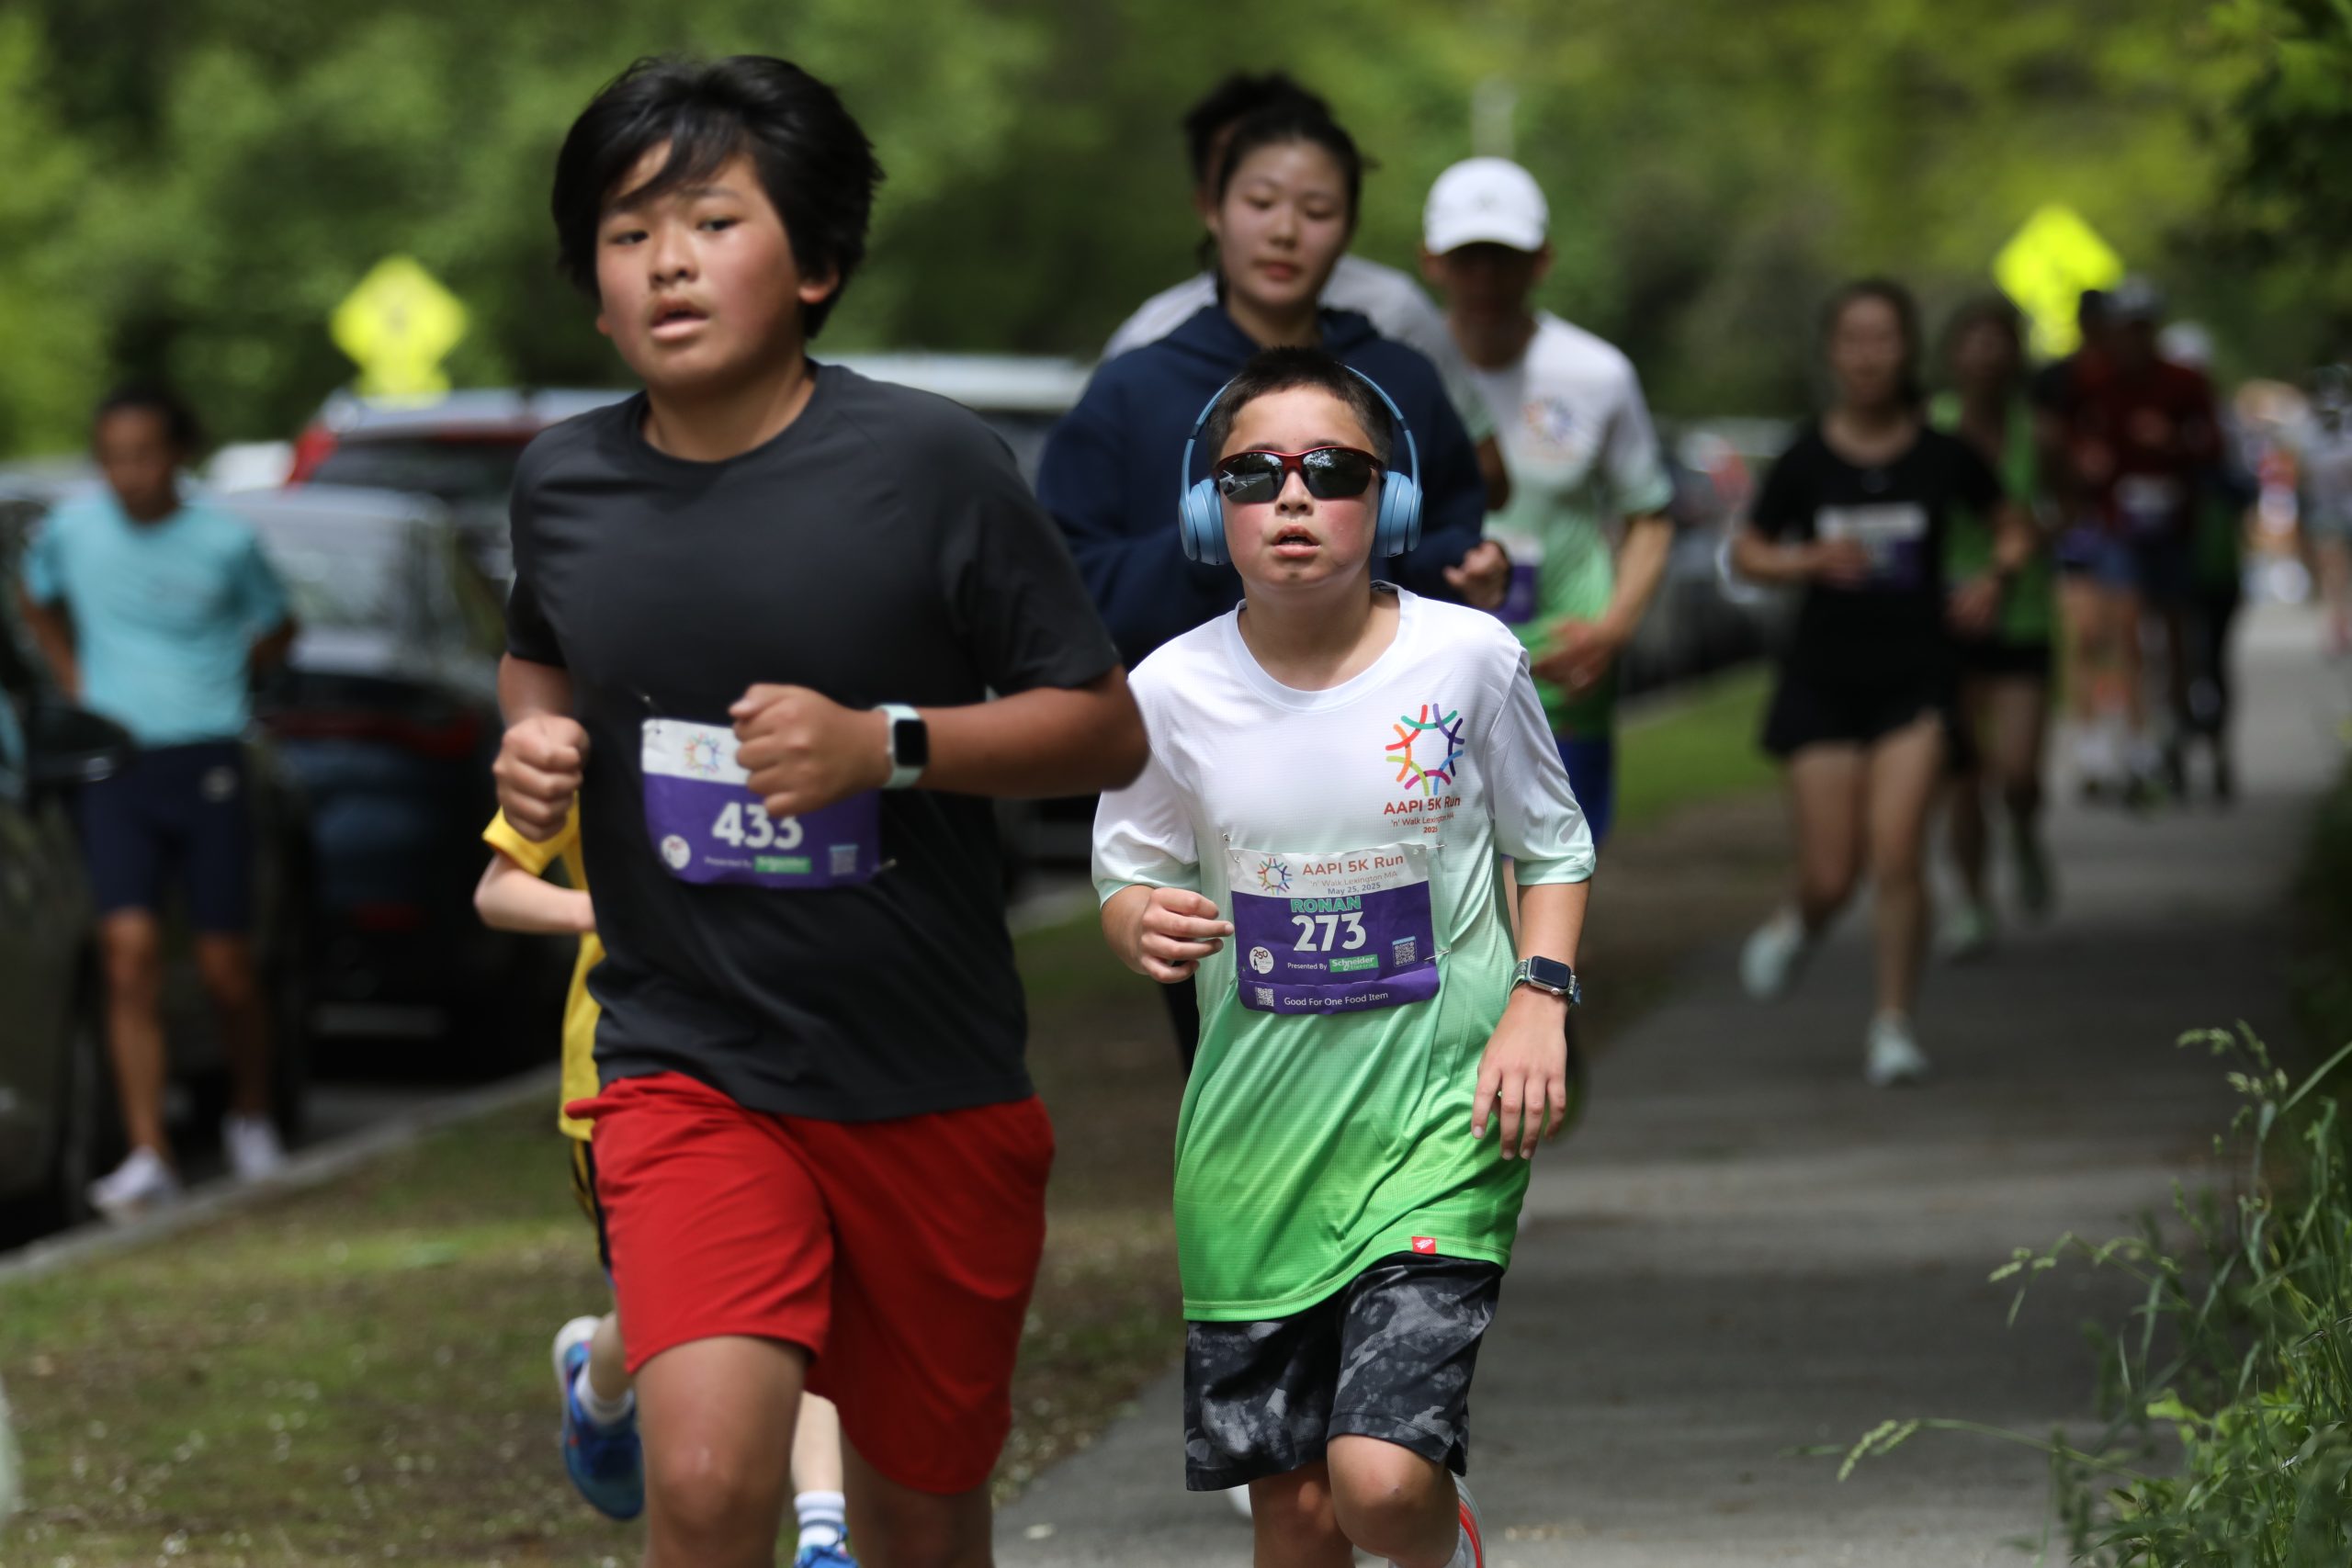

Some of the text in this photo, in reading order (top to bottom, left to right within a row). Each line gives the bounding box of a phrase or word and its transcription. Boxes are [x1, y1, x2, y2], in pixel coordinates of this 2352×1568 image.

[1384, 795, 1461, 815] AAPI 5K Run
[711, 802, 804, 850] 433
[1402, 818, 1421, 826] Walk
[1302, 855, 1404, 875] AAPI 5K Run
[1344, 874, 1383, 886] Lexington
[1384, 871, 1397, 879] MA
[1328, 882, 1381, 896] May 25, 2025
[1291, 896, 1362, 913] RONAN
[1291, 911, 1367, 952] 273
[1252, 949, 1269, 959] 250
[1331, 956, 1374, 967] Schneider
[1287, 962, 1328, 971] Presented By
[1283, 991, 1389, 1006] Good For One Food Item
